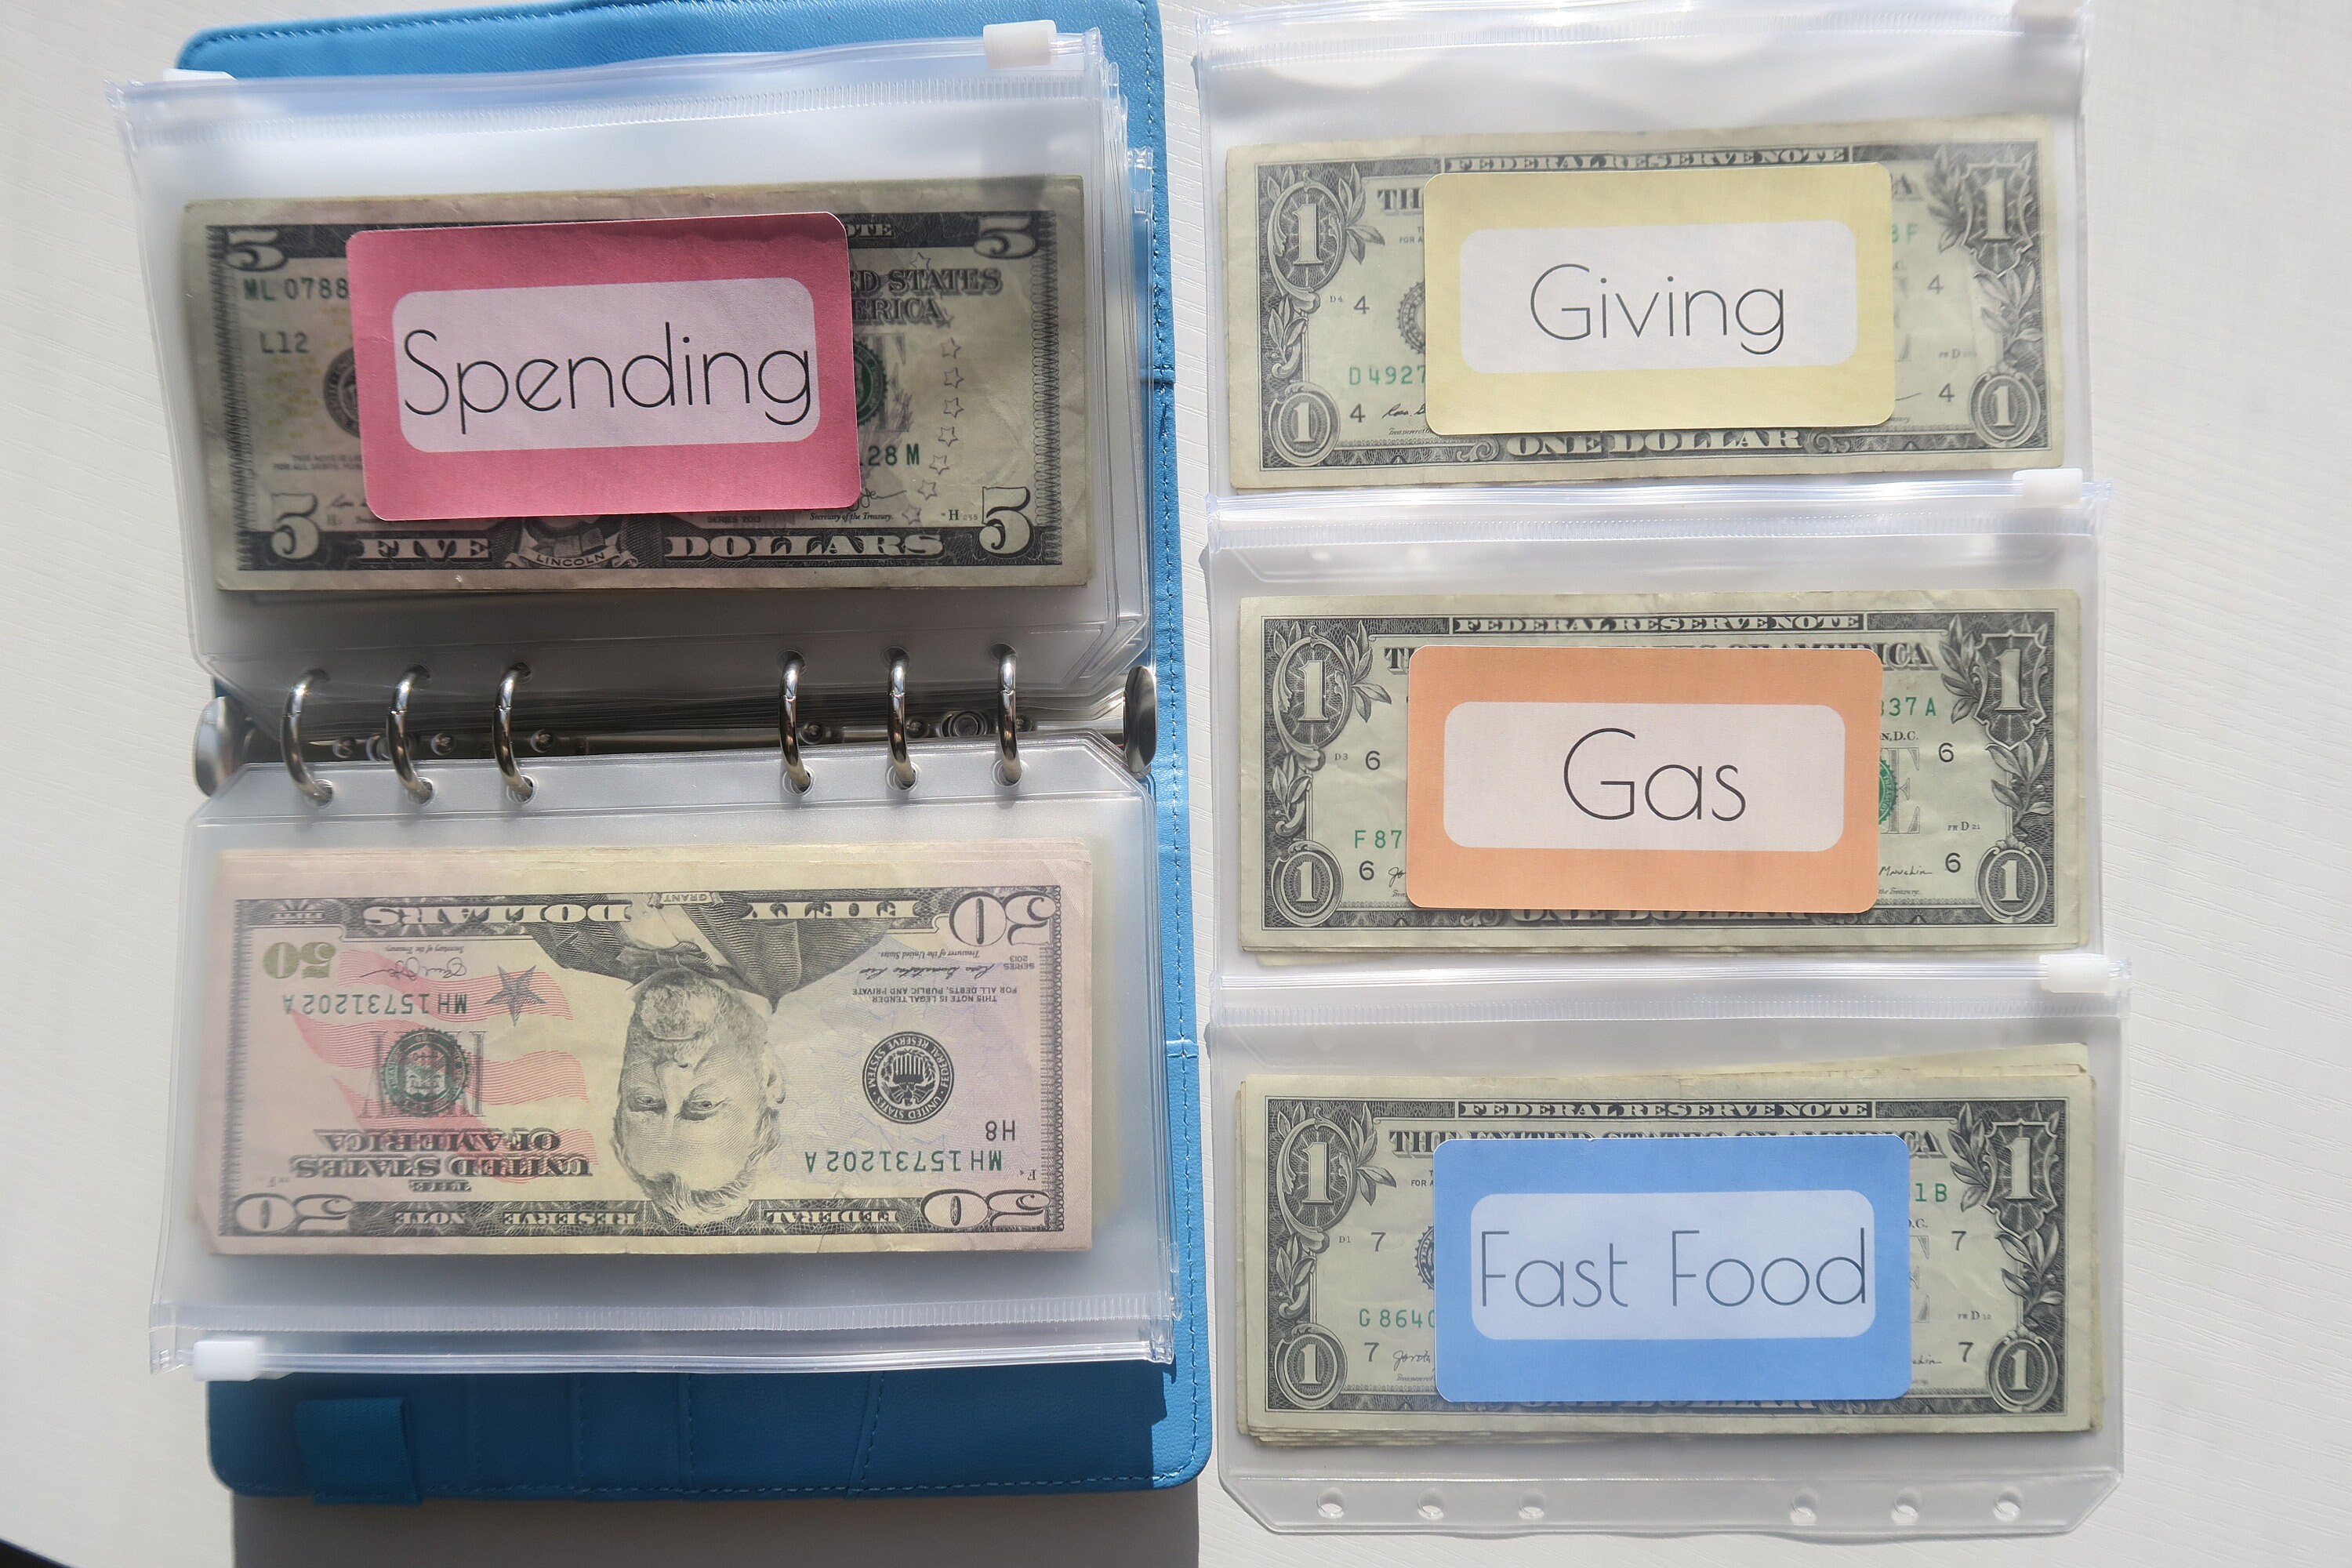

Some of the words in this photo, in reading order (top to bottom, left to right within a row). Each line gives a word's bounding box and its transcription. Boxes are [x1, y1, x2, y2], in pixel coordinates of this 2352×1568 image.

[1457, 156, 1612, 171] FEDERAL
[1616, 150, 1757, 169] RESERVE
[1760, 147, 1846, 165] NOTE
[1980, 178, 2013, 240] 1
[847, 224, 895, 236] OTE
[975, 216, 1040, 260] 5
[1292, 203, 1325, 266] 1
[224, 227, 289, 272] 5
[888, 268, 1004, 296] STATES
[1927, 274, 1944, 294] 4
[852, 297, 944, 325] ERICA
[1354, 295, 1370, 314] 4
[1530, 263, 1785, 355] Giving
[259, 331, 309, 354] L12
[403, 321, 811, 435] Spending
[1939, 383, 1955, 402] 4
[1349, 403, 1366, 423] 4
[1992, 386, 2015, 426] 1
[1293, 401, 1316, 444] 1
[1507, 432, 1603, 456] ONE
[1609, 429, 1802, 452] DOLLAR
[270, 493, 320, 560] 5
[810, 512, 841, 522] Secretary
[850, 512, 861, 521] the
[978, 486, 1033, 556] 5
[358, 537, 492, 561] FIVE
[535, 550, 607, 568] LINCOLN
[665, 535, 943, 560] DOLLARS
[1457, 617, 1617, 633] FEDERAL
[1622, 616, 1769, 632] RESERVE
[1773, 615, 1858, 631] NOTE
[1297, 659, 1330, 723] 1
[1995, 648, 2027, 713] 1
[1365, 750, 1381, 771] 6
[1938, 742, 1955, 763] 6
[1563, 727, 1747, 822] Gas
[1359, 860, 1375, 881] 6
[1945, 851, 1962, 873] 6
[1295, 861, 1318, 902] 1
[1999, 860, 2023, 902] 1
[662, 892, 708, 903] GRANT
[737, 898, 918, 919] FIFTY
[361, 902, 630, 925] DOLLARS
[948, 892, 1055, 946] 50
[262, 941, 335, 979] 50
[938, 948, 946, 958] of
[946, 949, 979, 957] Treasurer
[946, 985, 976, 994] DEBTS,
[885, 1035, 928, 1051] RESERVE
[866, 1047, 884, 1088] SYSTEM
[929, 1044, 950, 1087] FEDERAL
[873, 1095, 904, 1119] STATES
[906, 1095, 940, 1119] UNITED
[1465, 1102, 1620, 1117] FEDERAL
[1625, 1102, 1775, 1117] RESERVE
[1780, 1102, 1868, 1116] NOTE
[313, 1128, 500, 1152] AMERICA
[502, 1128, 561, 1152] OF
[984, 1119, 1015, 1141] H8
[289, 1155, 441, 1178] STATES
[448, 1154, 592, 1177] UNITED
[1301, 1142, 1333, 1206] 1
[2005, 1137, 2036, 1200] 1
[407, 1179, 471, 1192] THE
[234, 1192, 353, 1232] 50
[393, 1210, 466, 1224] NOTE
[503, 1210, 636, 1224] RESERVE
[764, 1209, 897, 1222] FEDERAL
[920, 1188, 1050, 1229] 50
[1370, 1232, 1387, 1252] 7
[1951, 1231, 1967, 1251] 7
[1480, 1230, 1629, 1308] Fast
[1671, 1226, 1867, 1308] Food
[1298, 1343, 1321, 1385] 1
[1363, 1342, 1380, 1363] 7
[1958, 1341, 1974, 1363] 7
[2009, 1348, 2031, 1391] 1
